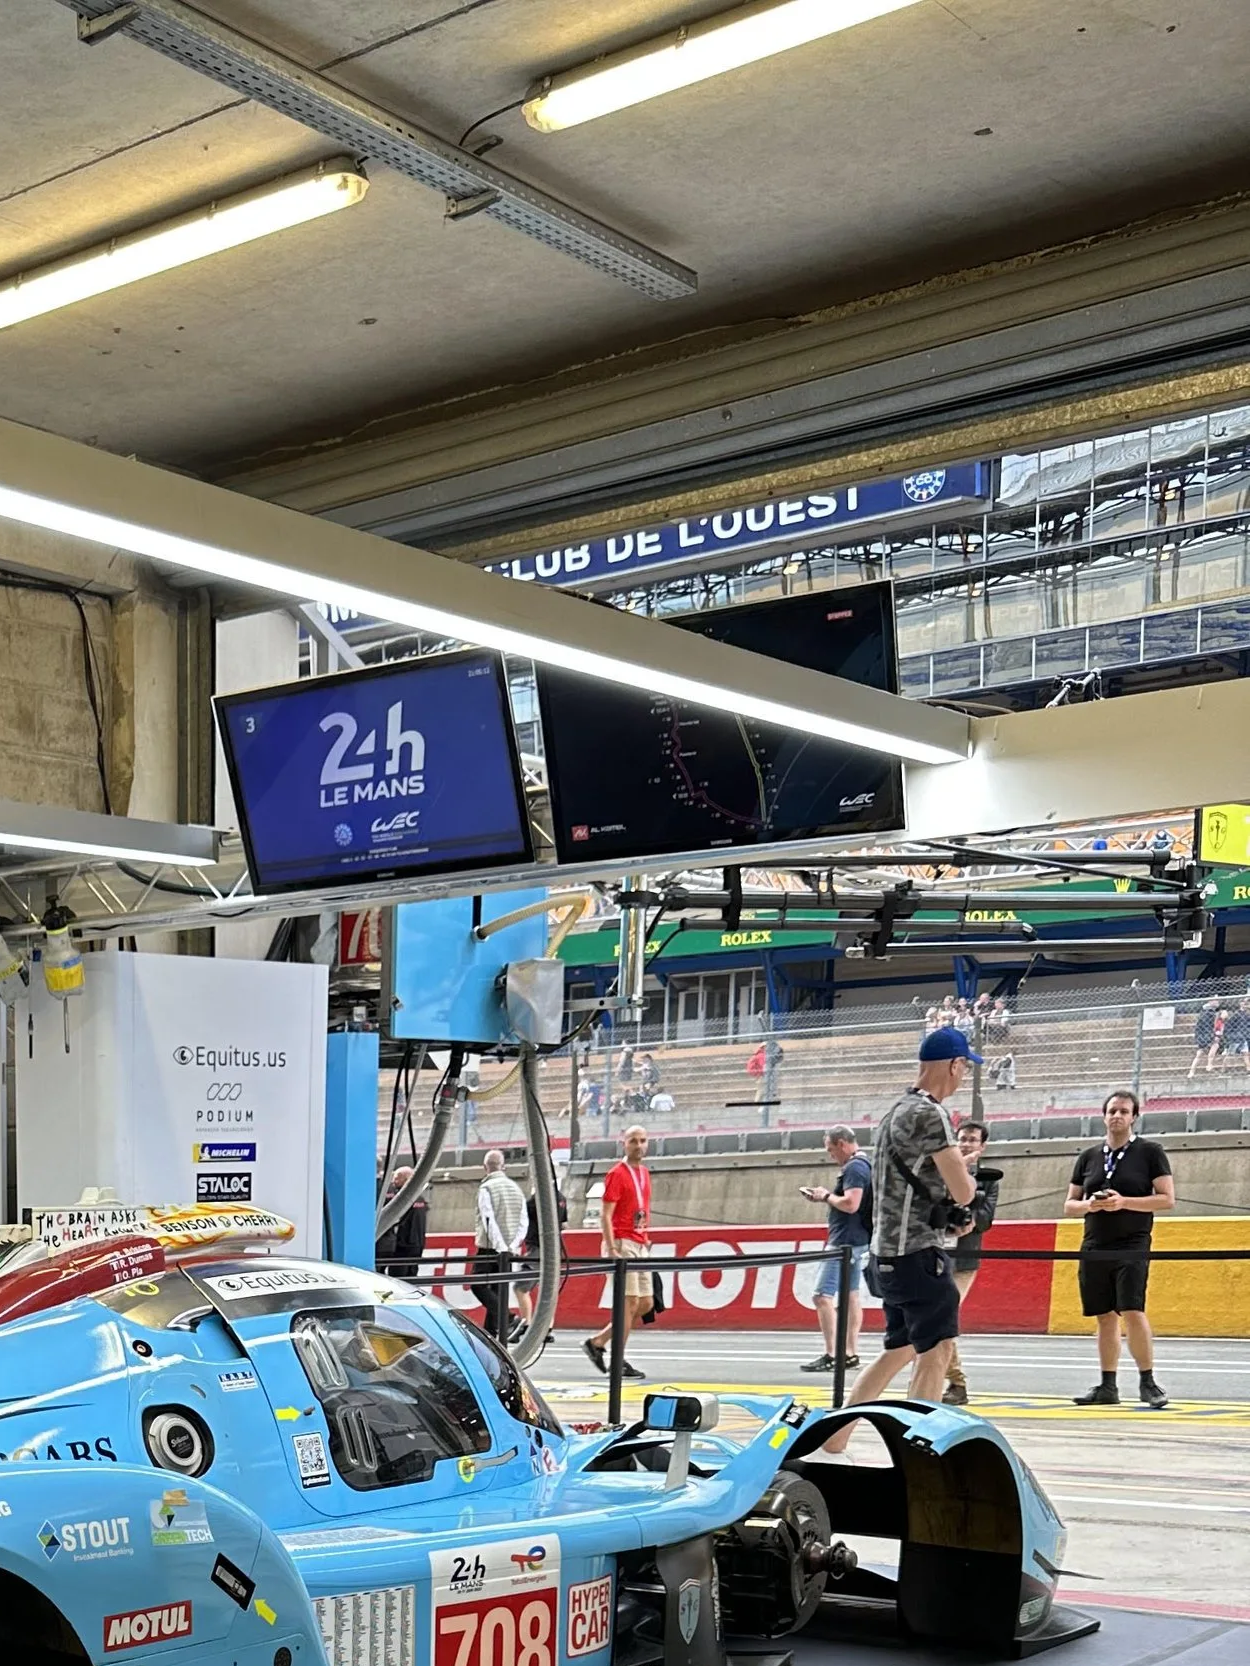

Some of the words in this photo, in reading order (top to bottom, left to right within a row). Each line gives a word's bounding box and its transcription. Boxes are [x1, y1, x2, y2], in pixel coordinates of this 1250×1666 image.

[483, 544, 591, 581] LUB
[245, 717, 256, 734] 3
[319, 786, 348, 808] LE
[353, 774, 425, 804] MANS
[371, 810, 420, 832] WEC
[720, 930, 772, 947] ROLEX
[196, 1046, 286, 1072] Equitus.us
[197, 1110, 254, 1122] PODIUM
[211, 1149, 250, 1157] MICHELIN
[198, 1177, 249, 1193] STALOC
[160, 1217, 217, 1233] BENSON
[233, 1213, 280, 1227] CHERRY
[129, 1253, 153, 1264] Dumas
[131, 1267, 143, 1276] Pla
[61, 1517, 129, 1551] STOUT
[460, 1580, 484, 1589] MANS
[572, 1582, 610, 1613] HYPER
[106, 1604, 190, 1648] MOTUL
[571, 1604, 609, 1650] CAR
